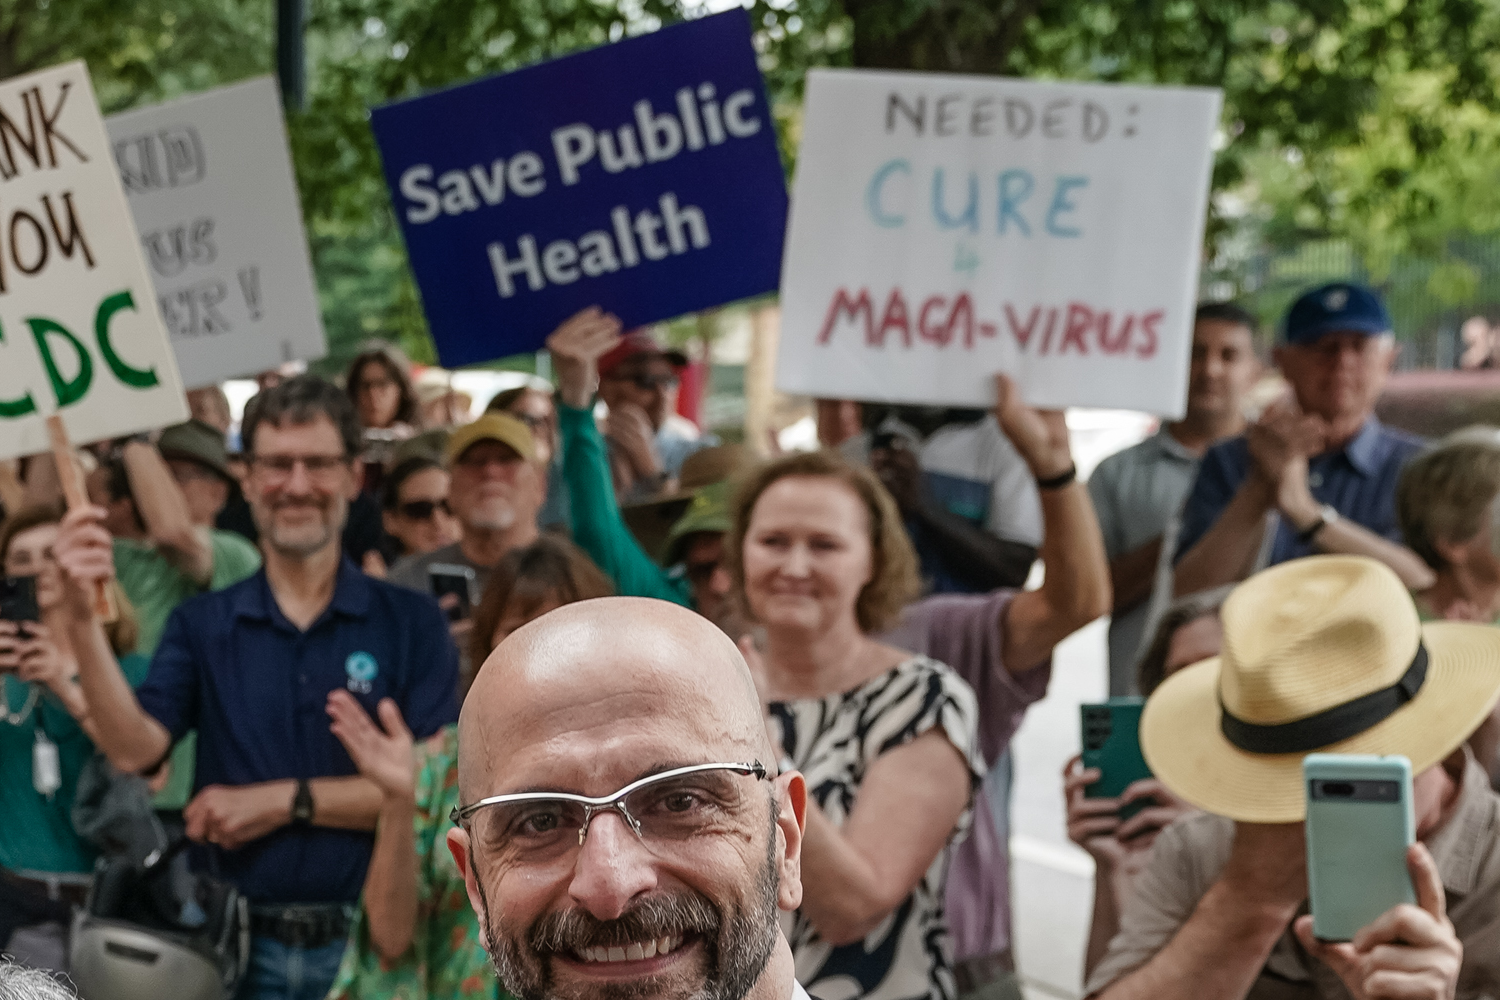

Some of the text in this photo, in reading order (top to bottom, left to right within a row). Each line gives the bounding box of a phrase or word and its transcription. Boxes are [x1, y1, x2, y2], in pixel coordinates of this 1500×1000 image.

[399, 82, 762, 224] Save Public
[884, 93, 1140, 143] NEEDED:
[864, 158, 1092, 238] CURE
[487, 192, 711, 298] Health
[815, 286, 1167, 359] MAGA-VIRUS
